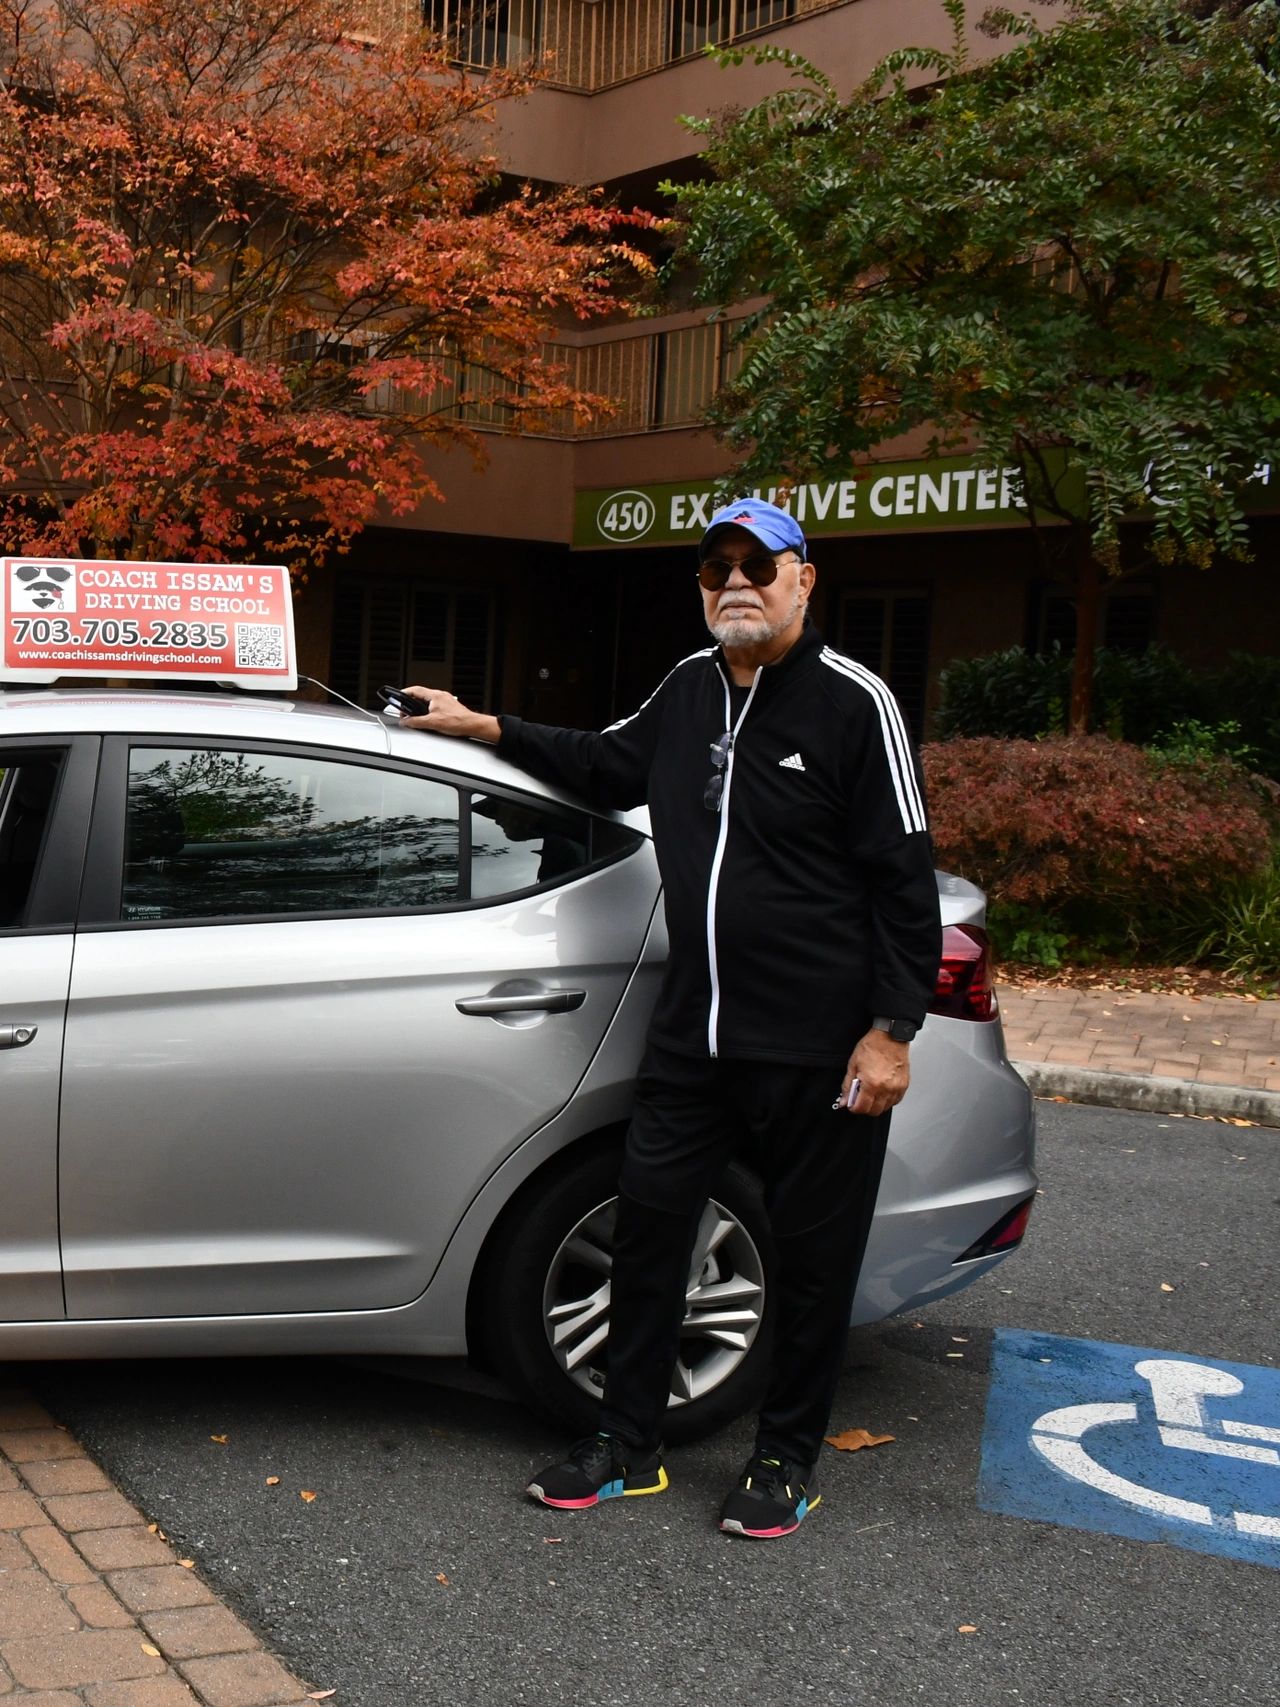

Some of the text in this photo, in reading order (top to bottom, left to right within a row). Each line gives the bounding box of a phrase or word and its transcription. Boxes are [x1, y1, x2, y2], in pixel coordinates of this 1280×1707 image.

[604, 501, 647, 531] 450
[79, 570, 274, 594] COACH ISSAM'S
[85, 593, 270, 615] DRIVING SCHOOL
[11, 619, 228, 648] 703.705.2835
[19, 650, 222, 665] www.coachissamsdrivingschool.com
